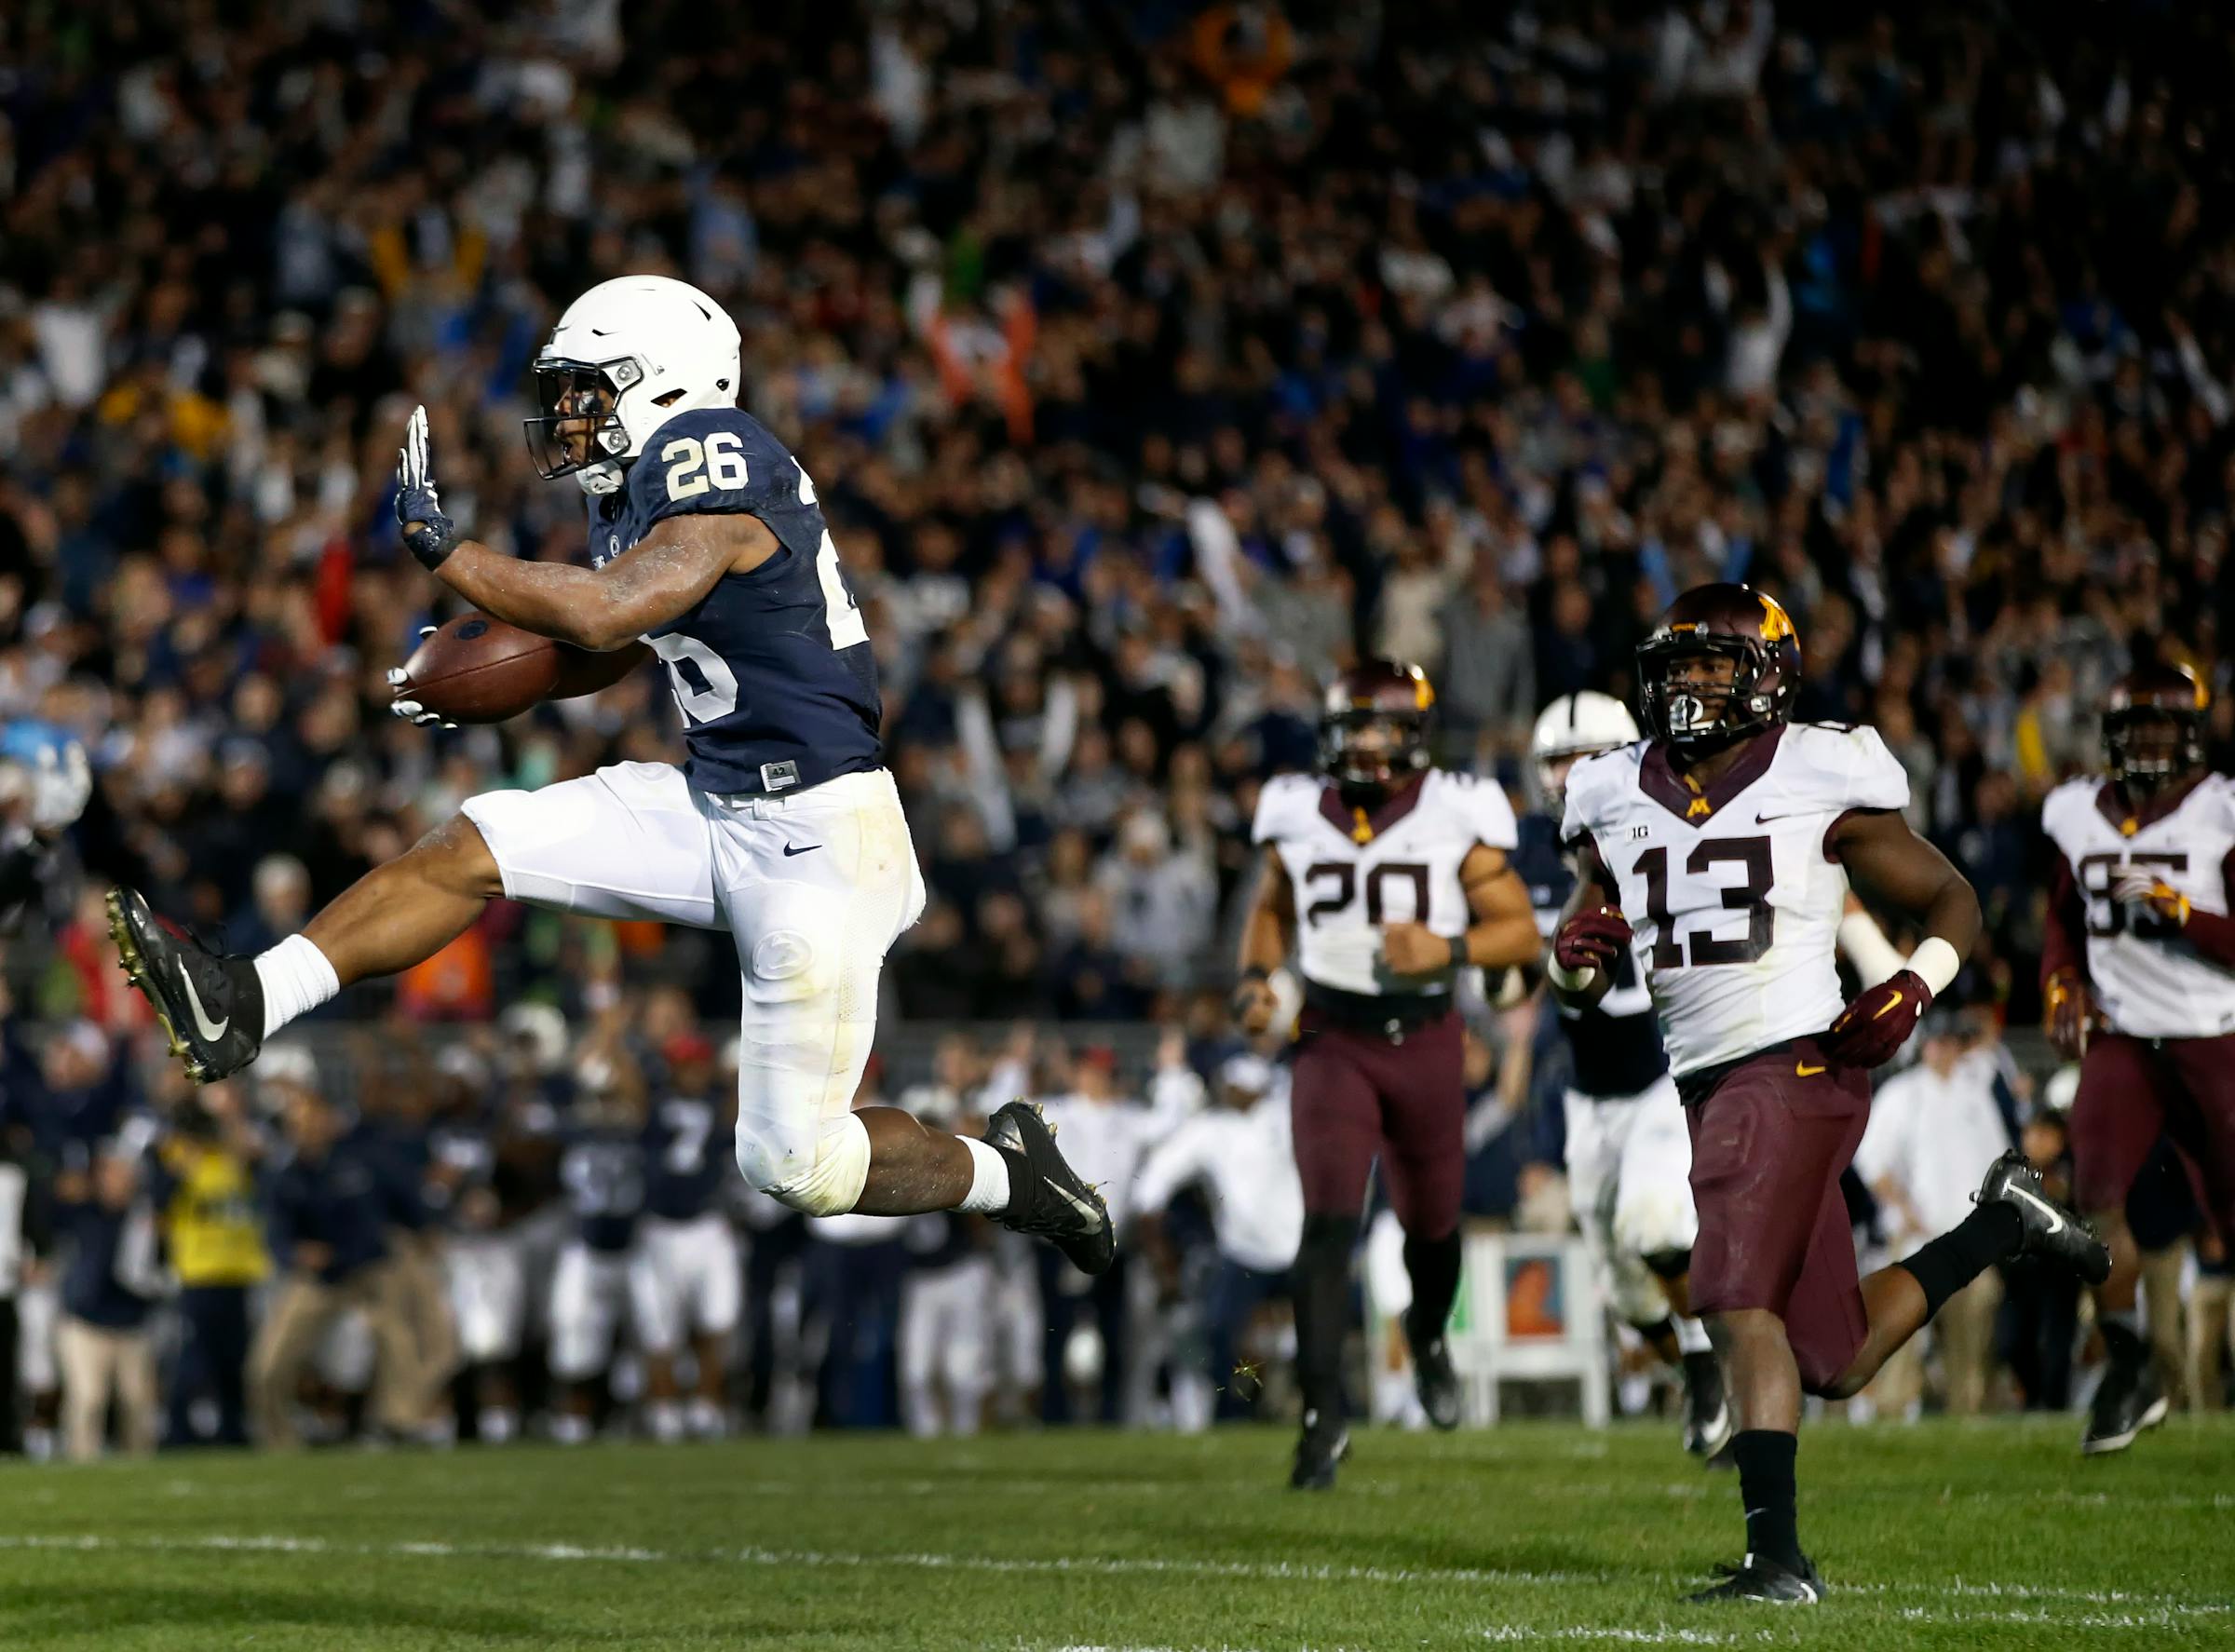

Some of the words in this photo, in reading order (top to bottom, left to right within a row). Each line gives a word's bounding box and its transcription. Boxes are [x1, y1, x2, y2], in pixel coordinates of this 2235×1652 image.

[661, 431, 749, 502] 26
[638, 632, 738, 728] 6
[1306, 862, 1429, 928] 20
[1632, 835, 1775, 969] 13
